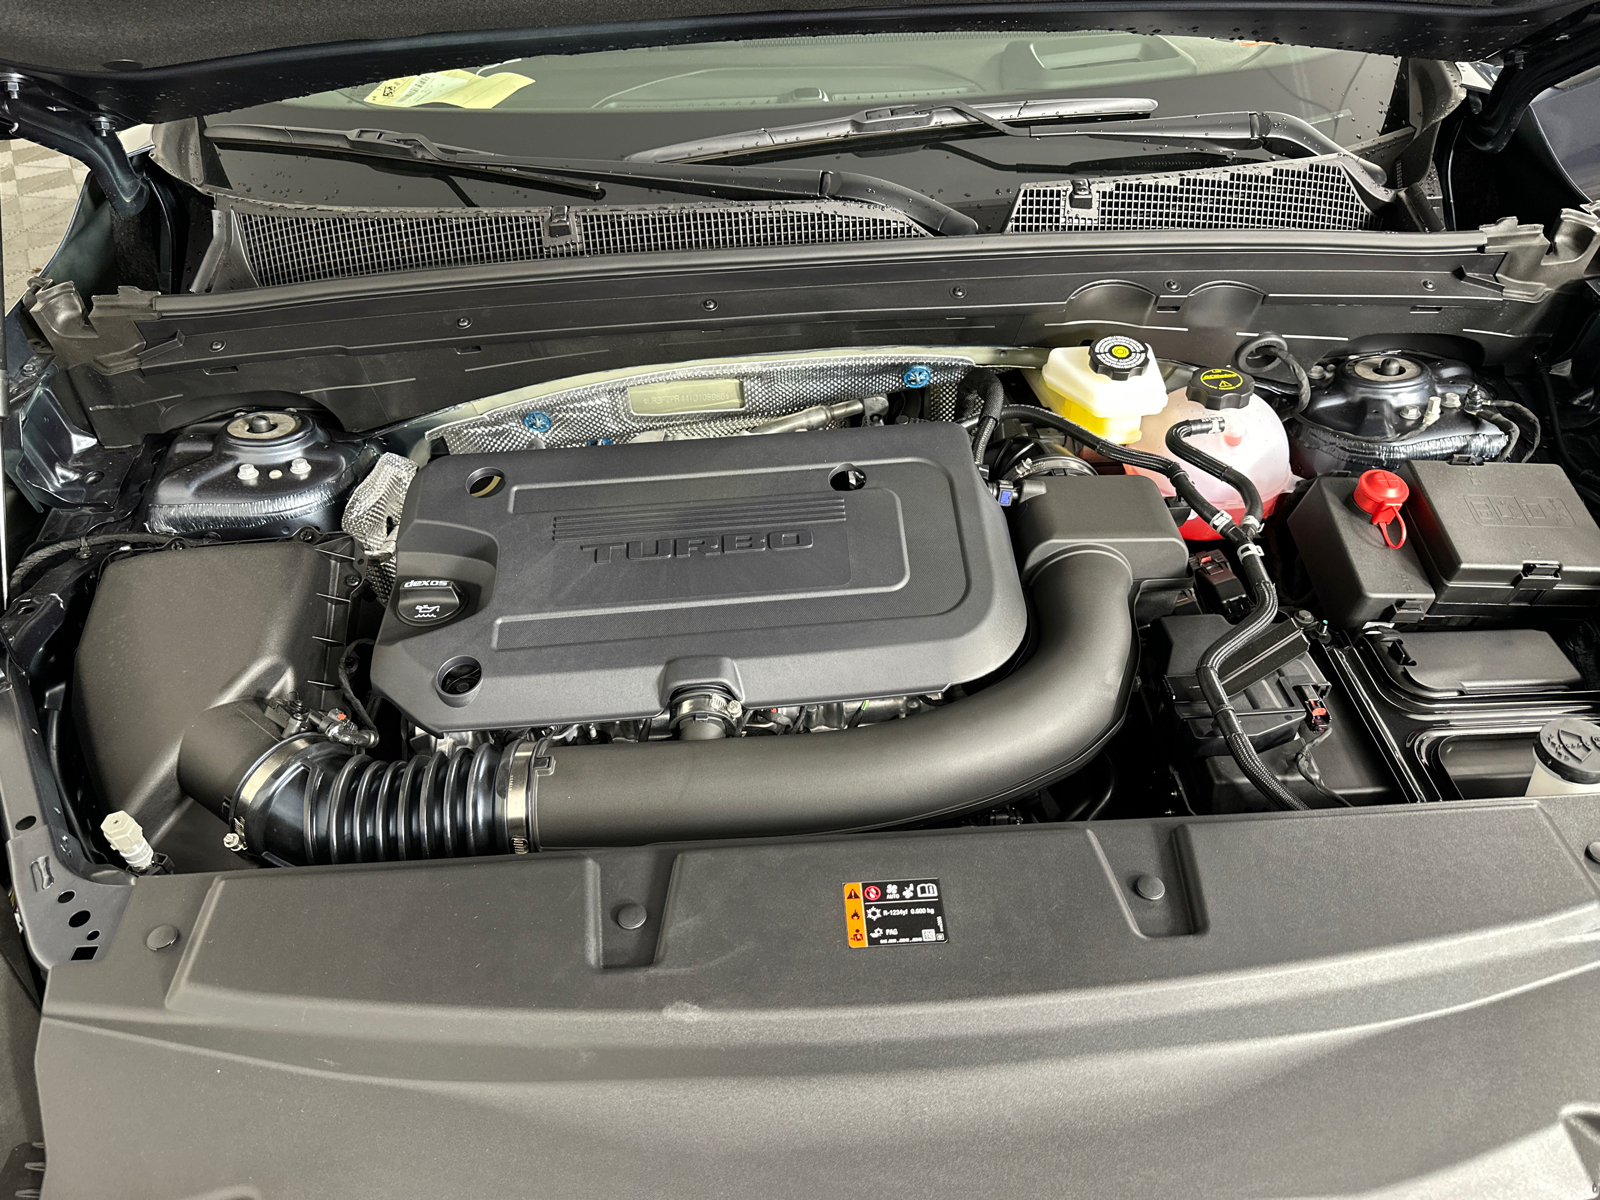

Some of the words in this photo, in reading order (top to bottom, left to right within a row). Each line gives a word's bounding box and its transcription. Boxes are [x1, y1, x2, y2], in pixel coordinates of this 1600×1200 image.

[579, 529, 814, 564] TURBO
[403, 579, 450, 588] dexos
[885, 928, 898, 936] PAG
